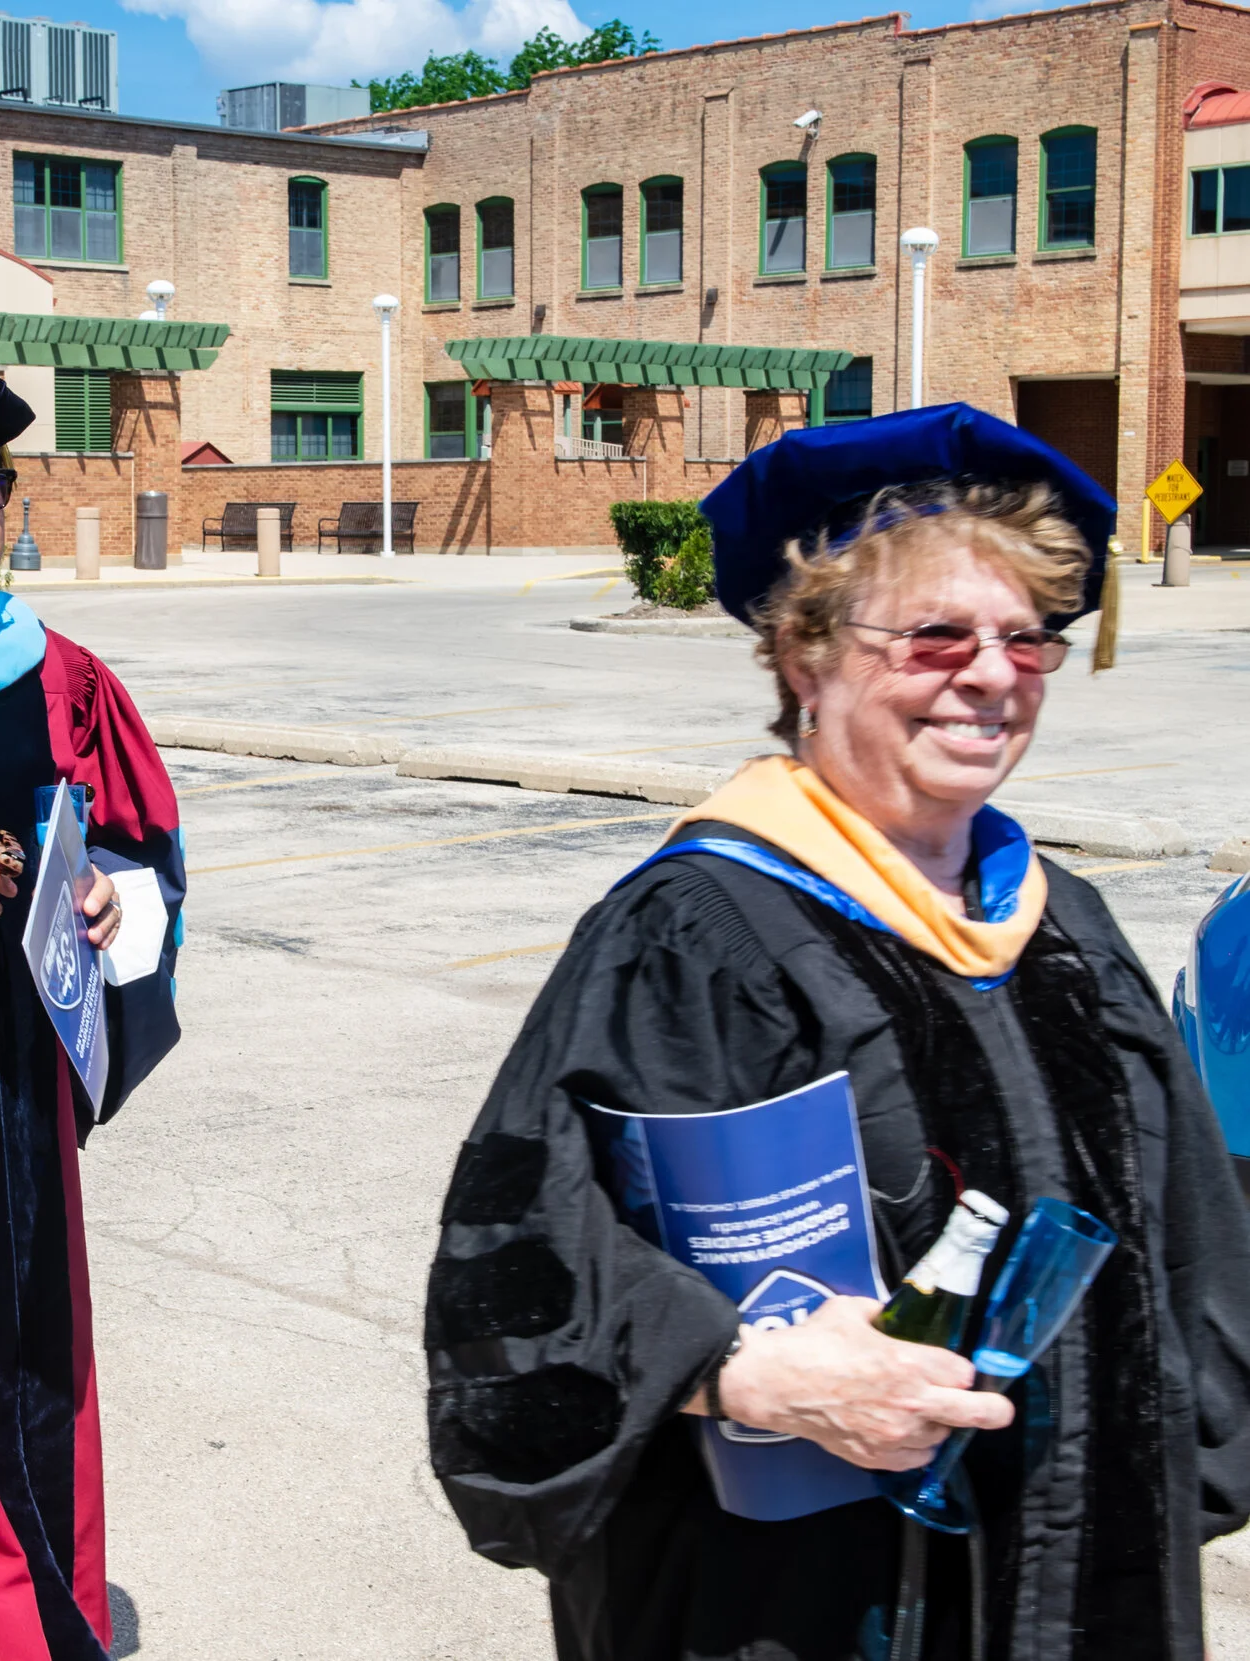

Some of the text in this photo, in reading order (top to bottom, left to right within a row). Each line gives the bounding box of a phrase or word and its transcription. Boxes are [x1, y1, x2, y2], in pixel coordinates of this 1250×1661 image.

[1154, 492, 1190, 502] PEDESTRIANS
[75, 962, 96, 1053] PSYCHODYNAMIC
[690, 1218, 850, 1264] PSYCHODYNAMIC
